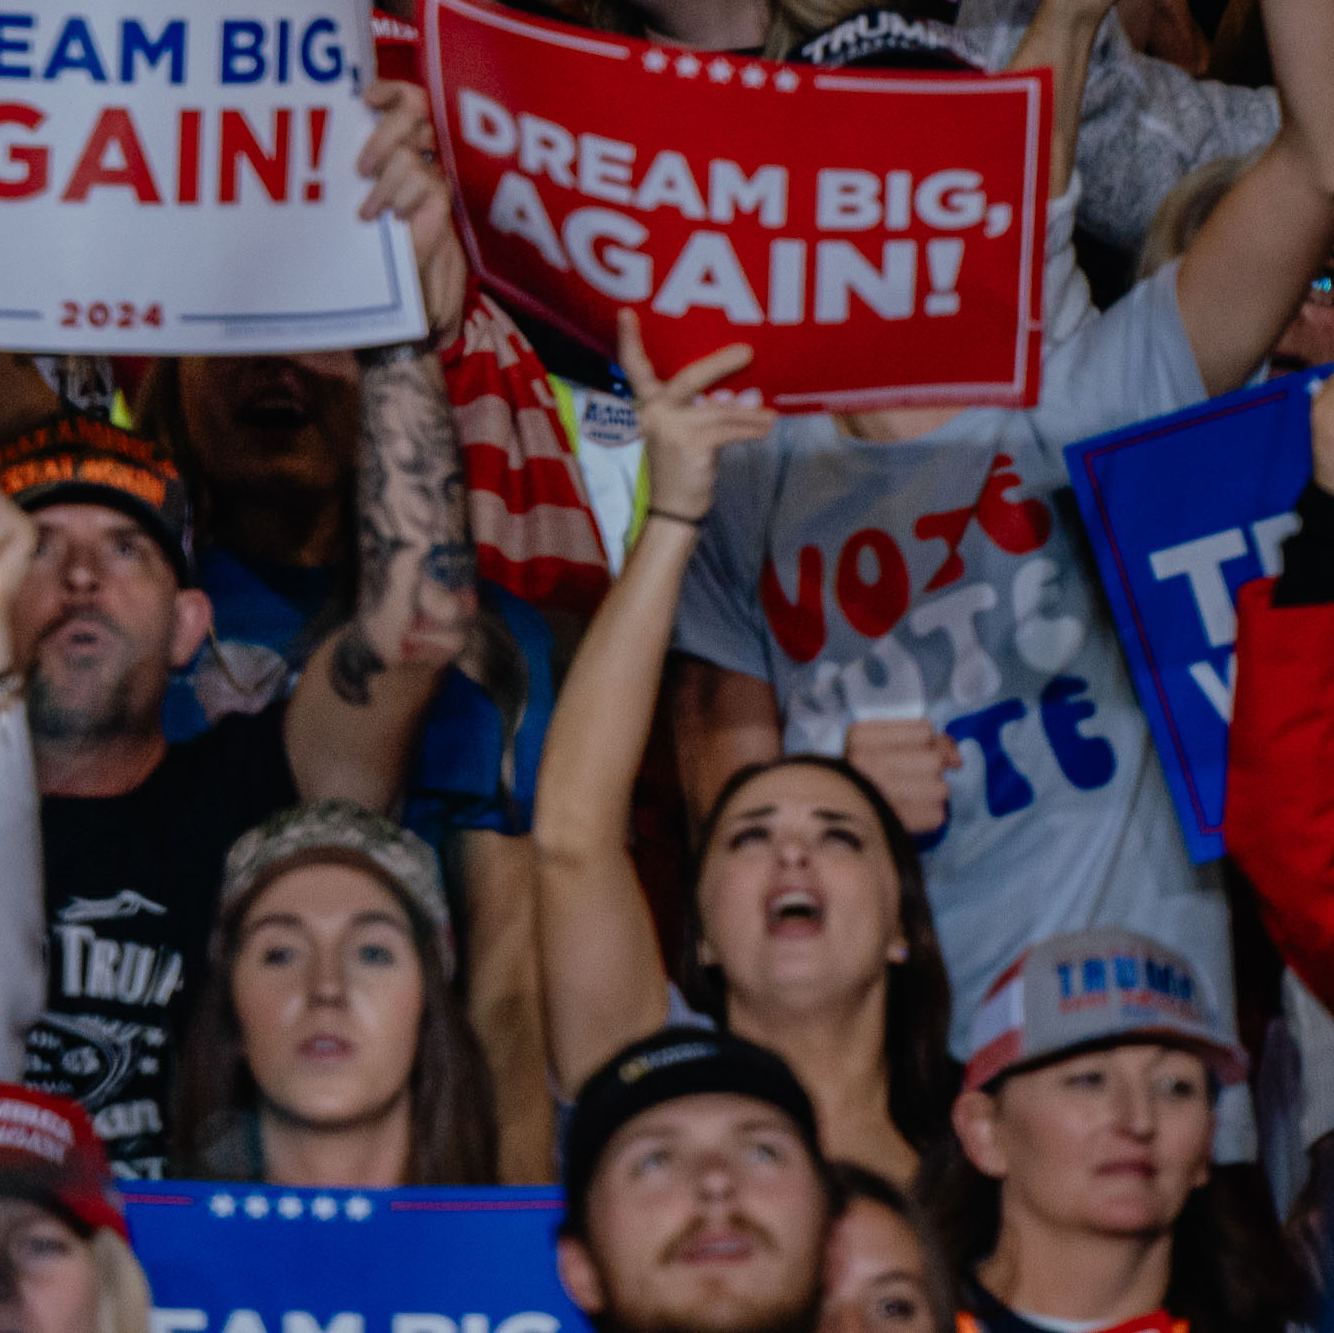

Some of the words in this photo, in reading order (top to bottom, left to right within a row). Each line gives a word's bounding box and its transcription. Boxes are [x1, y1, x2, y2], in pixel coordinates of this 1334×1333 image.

[219, 17, 363, 98] BIG,
[458, 89, 789, 229] DREAM
[815, 168, 1012, 238] BIG,
[60, 301, 164, 330] 2024
[488, 171, 965, 326] AGAIN!
[760, 453, 1051, 664] VOTE
